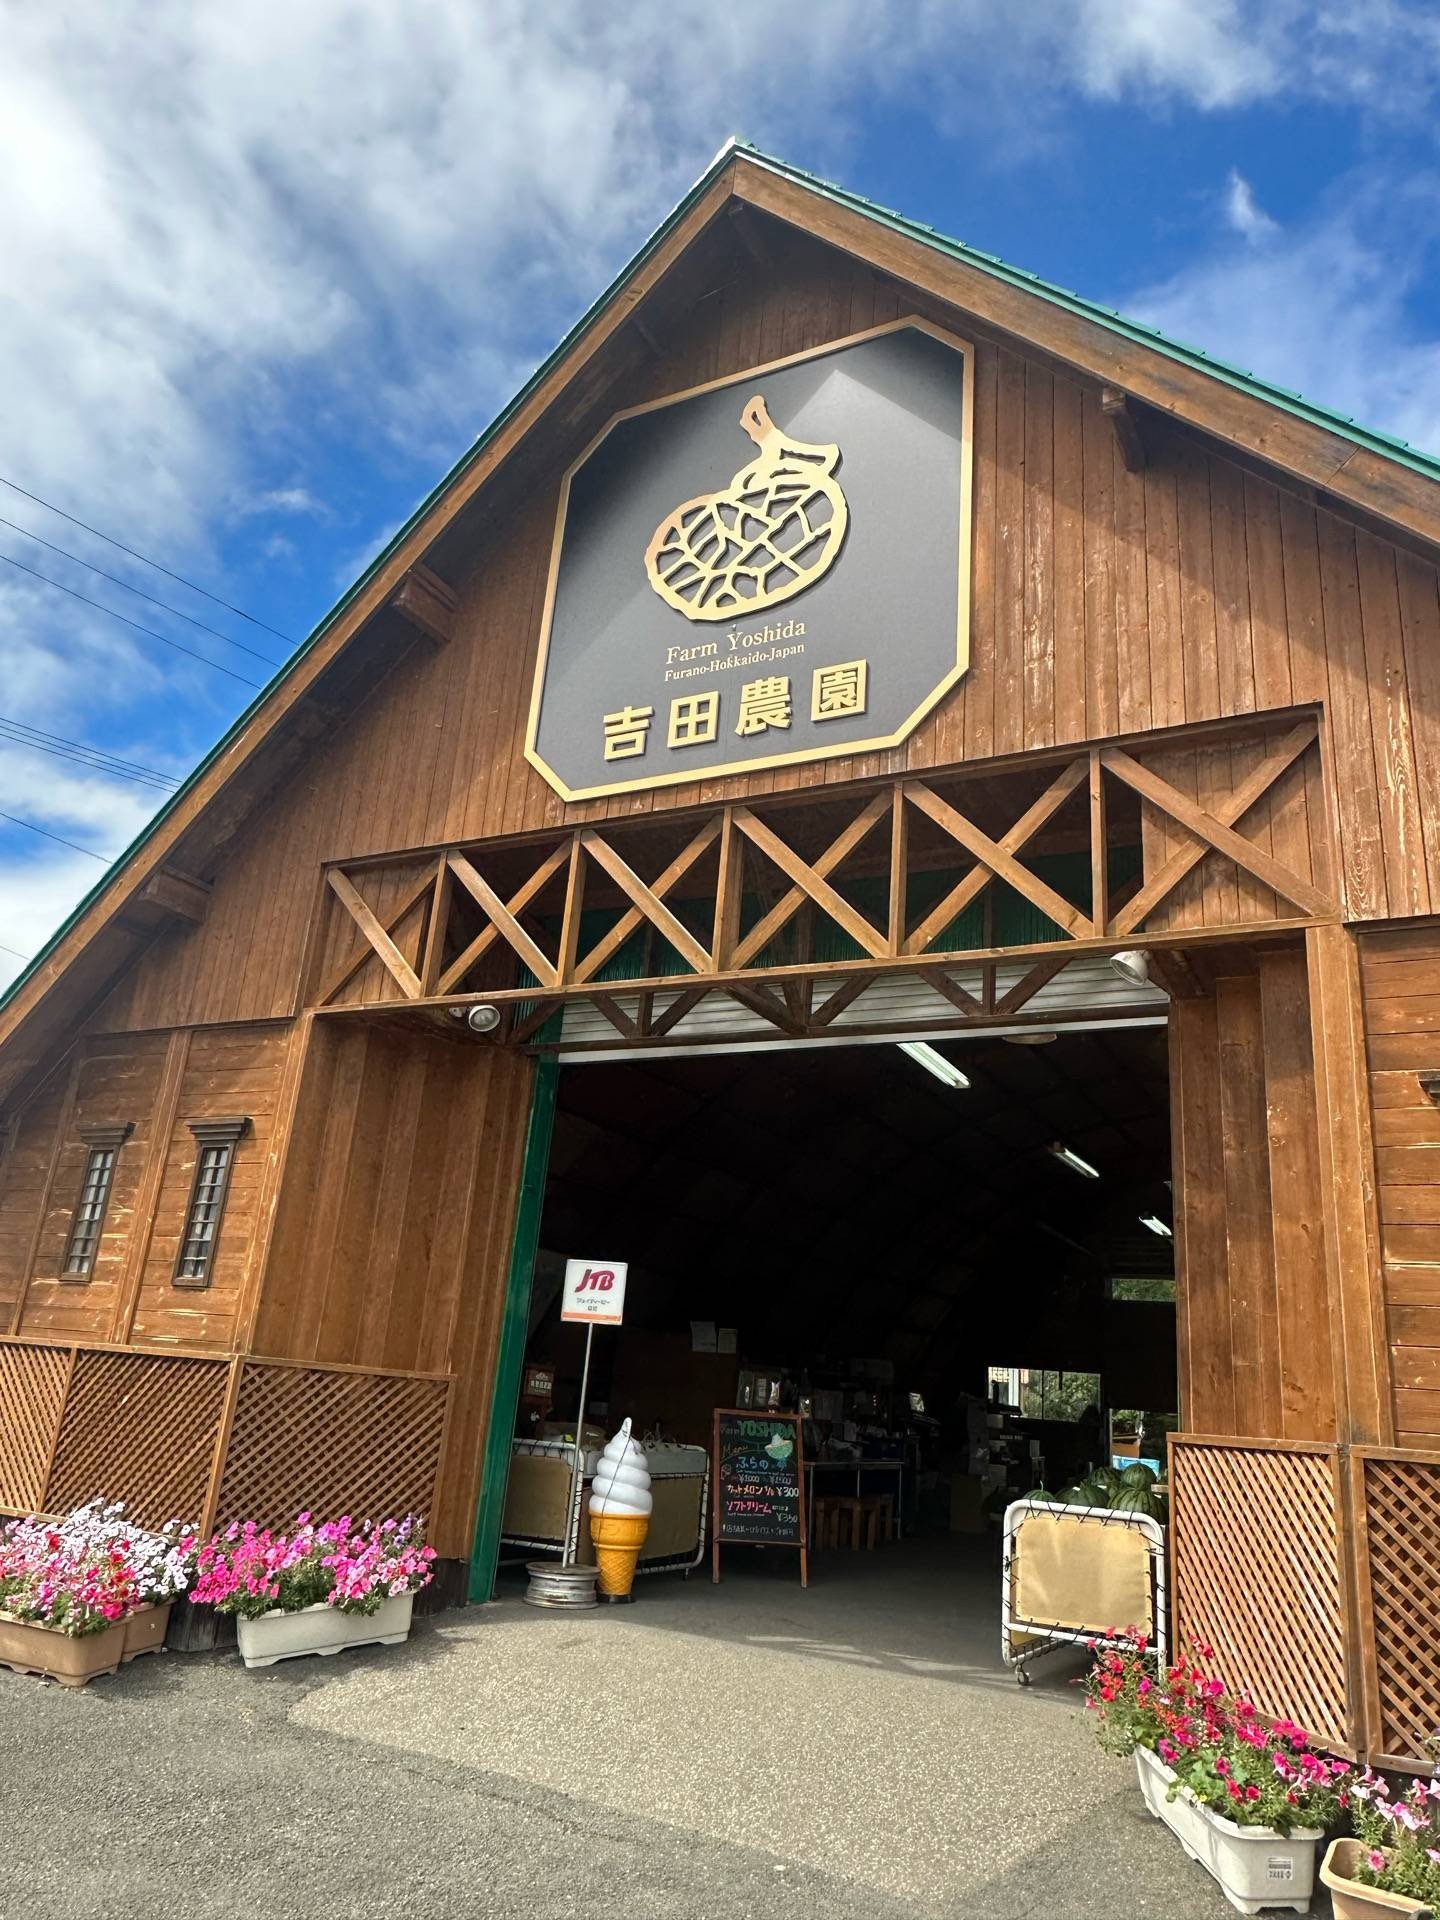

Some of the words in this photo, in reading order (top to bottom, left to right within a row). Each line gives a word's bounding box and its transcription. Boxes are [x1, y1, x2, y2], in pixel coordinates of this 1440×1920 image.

[665, 641, 719, 665] Farm
[726, 620, 807, 652] Yoshida
[602, 658, 868, 763] 吉田農園
[575, 1269, 615, 1292] JTB
